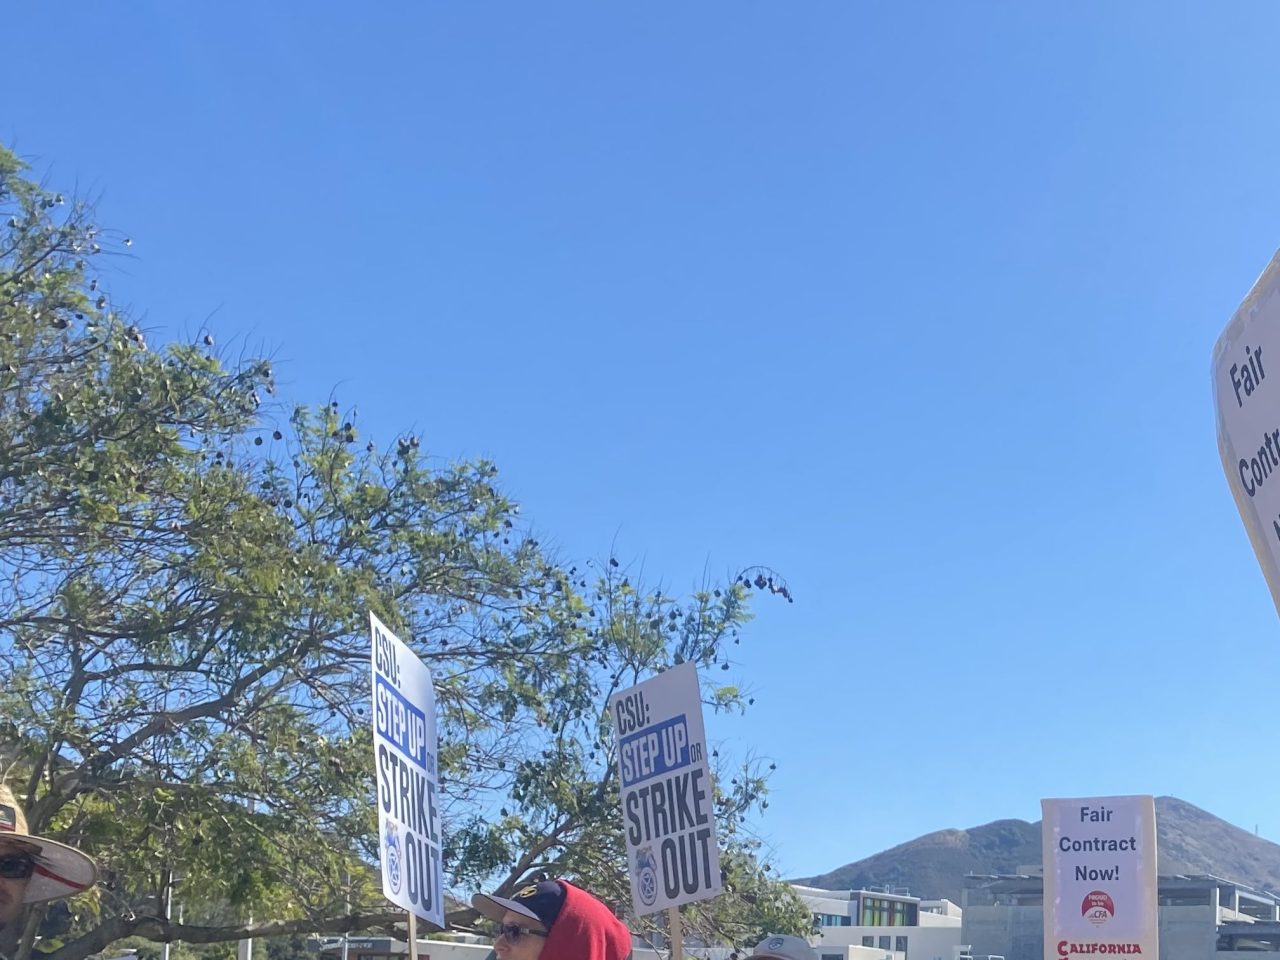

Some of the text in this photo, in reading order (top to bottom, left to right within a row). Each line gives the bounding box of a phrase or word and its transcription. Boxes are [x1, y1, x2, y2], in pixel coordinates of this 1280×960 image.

[1230, 345, 1266, 408] Fair
[375, 626, 401, 689] CSU:
[377, 682, 407, 745] STEP
[406, 709, 425, 758] UP
[616, 691, 650, 735] CSU:
[622, 721, 703, 783] STEP UP OR
[378, 743, 439, 845] STRIKE
[626, 768, 709, 847] STRIKE
[1080, 806, 1113, 823] Fair
[405, 829, 441, 916] OUT
[660, 827, 712, 899] OUT
[1059, 836, 1136, 852] Contract
[1075, 865, 1120, 881] Now!
